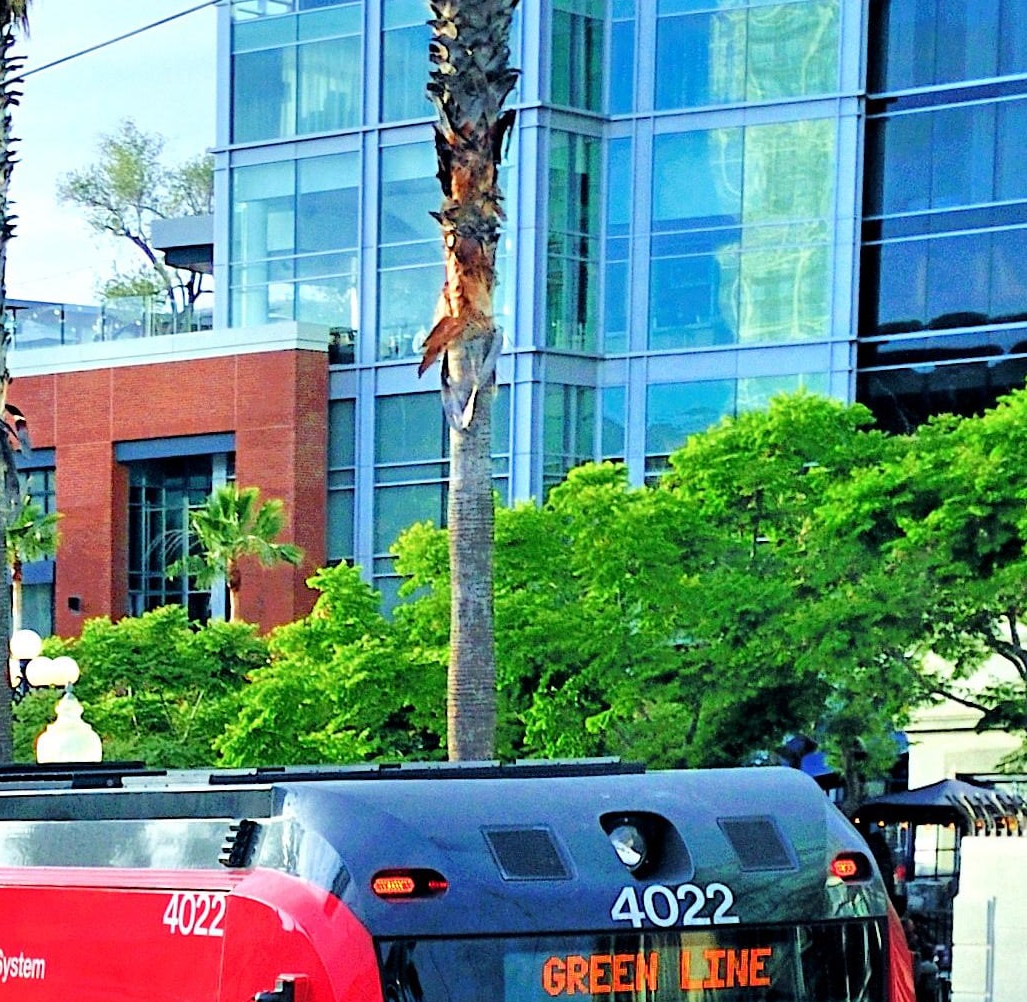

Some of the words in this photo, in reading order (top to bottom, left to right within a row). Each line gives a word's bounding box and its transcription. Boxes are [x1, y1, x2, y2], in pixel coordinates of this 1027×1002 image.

[162, 891, 227, 937] 4022
[610, 882, 741, 929] 4022
[541, 951, 659, 996] GREEN
[679, 946, 772, 990] LINE
